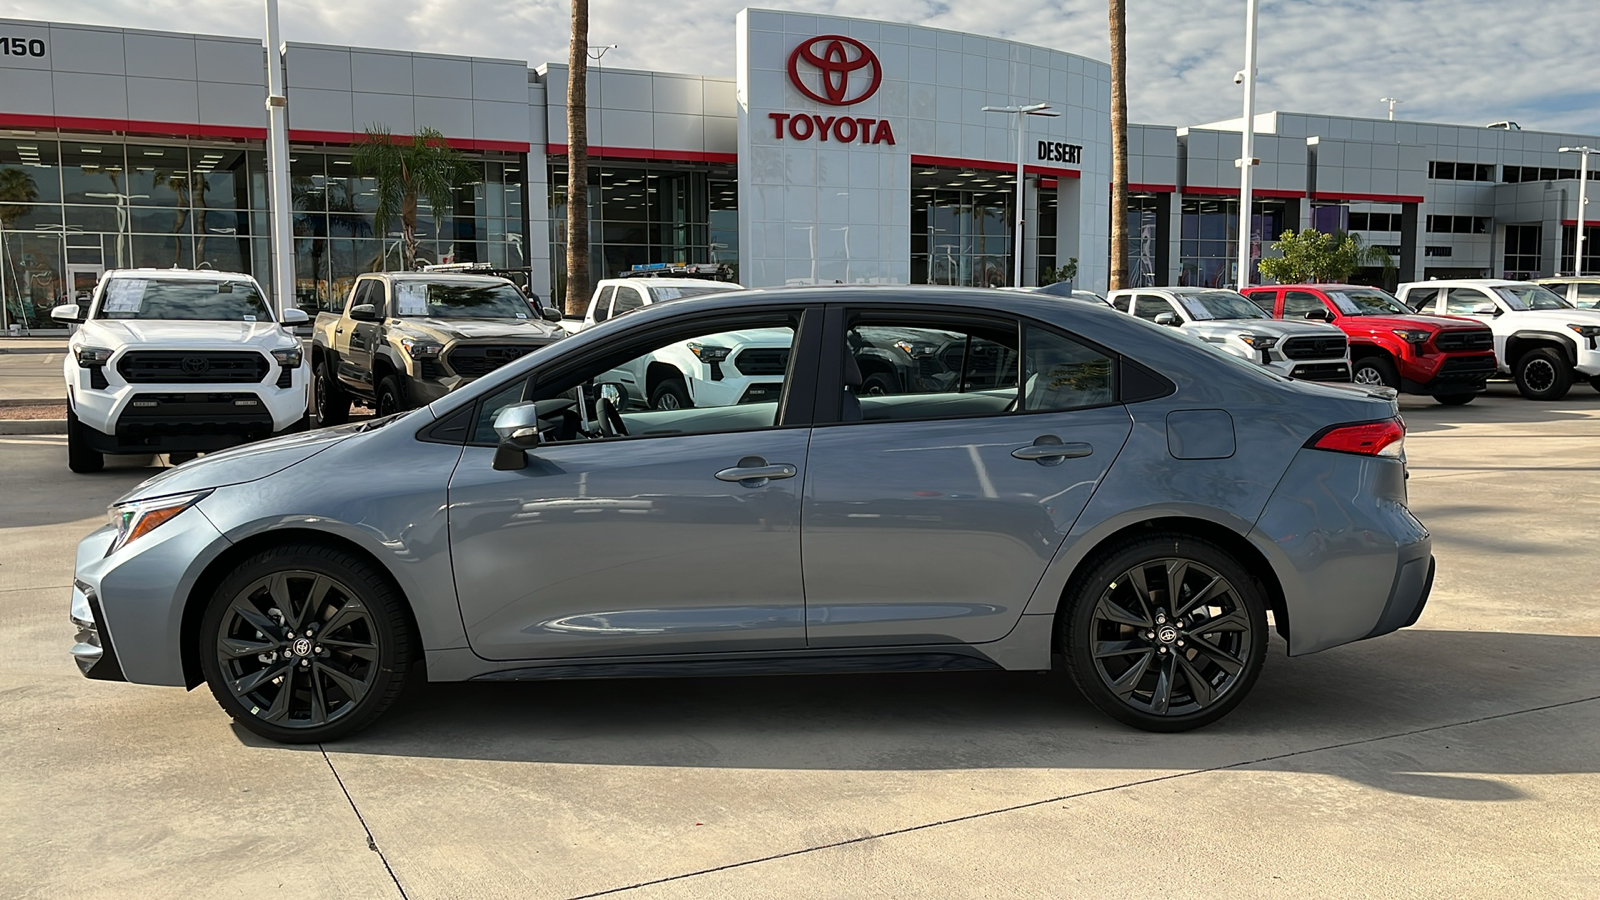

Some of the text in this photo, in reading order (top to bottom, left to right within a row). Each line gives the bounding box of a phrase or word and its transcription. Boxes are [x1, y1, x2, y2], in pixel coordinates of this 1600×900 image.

[0, 37, 46, 57] 150
[768, 113, 896, 145] TOYOTA
[1037, 140, 1083, 164] DESERT
